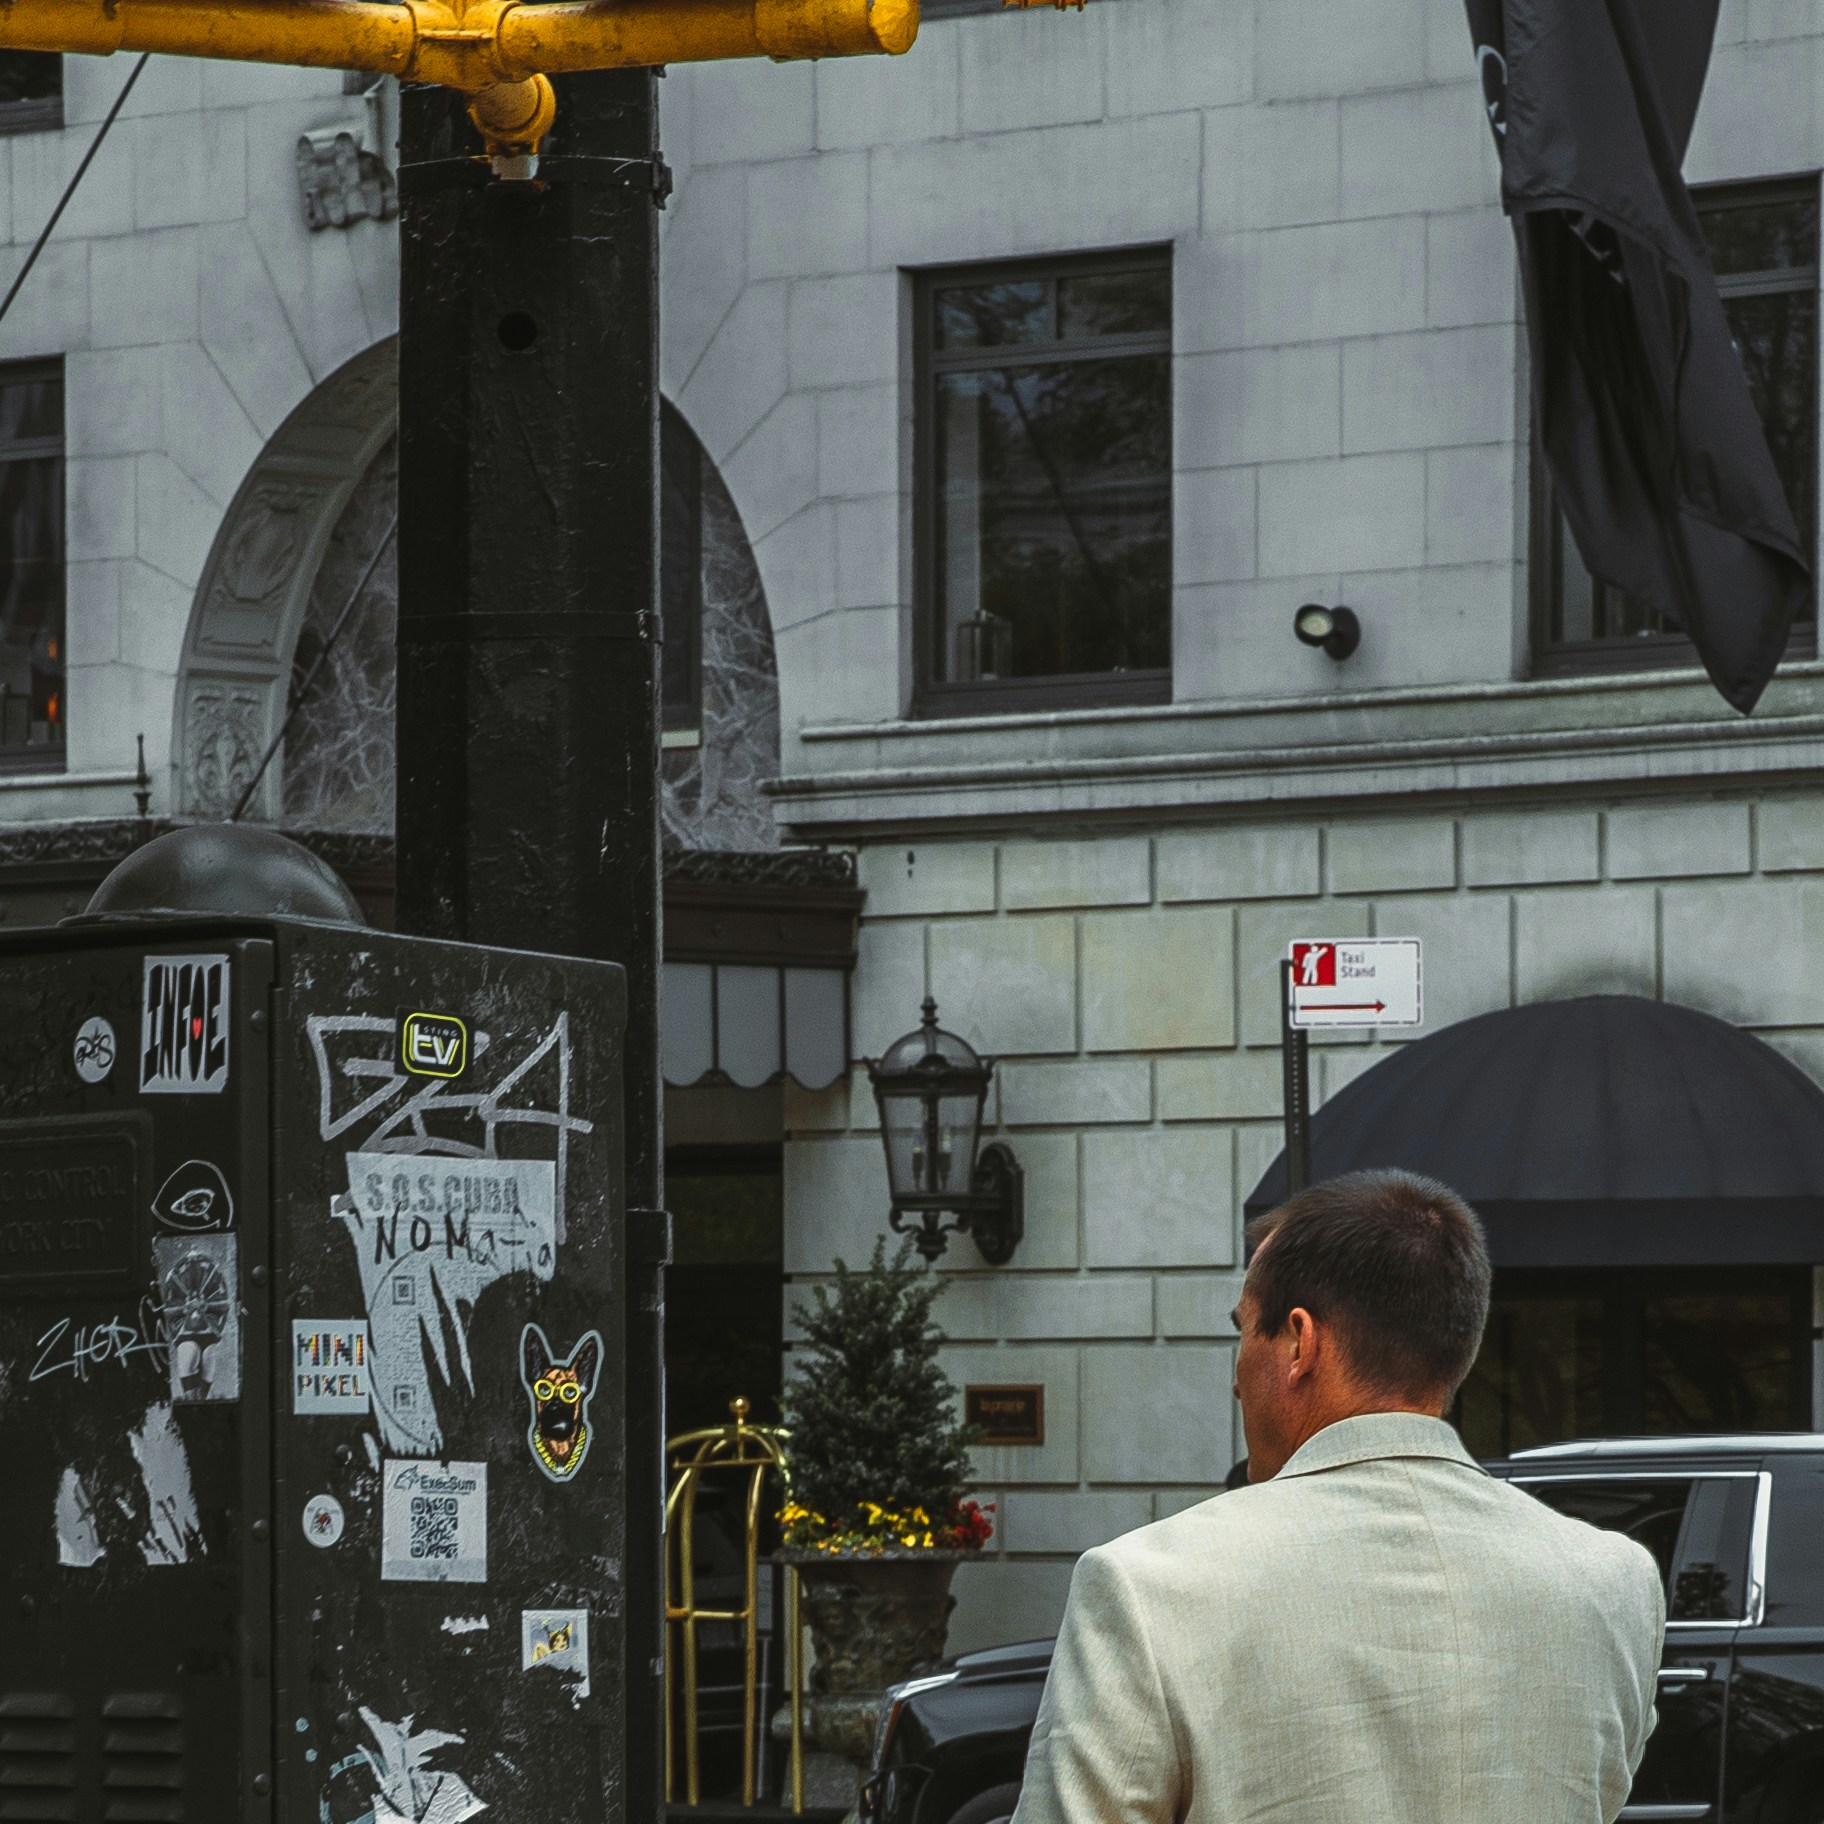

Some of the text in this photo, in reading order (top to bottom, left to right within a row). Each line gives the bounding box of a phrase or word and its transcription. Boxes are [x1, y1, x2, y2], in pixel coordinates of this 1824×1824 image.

[1341, 952, 1365, 964] Taxi
[1341, 966, 1376, 979] Stand
[24, 1165, 127, 1200] CONTROL
[61, 1216, 112, 1250] CITY
[296, 1333, 364, 1367] MINI
[297, 1374, 366, 1397] PIXEL
[420, 1474, 476, 1492] ExecSum
